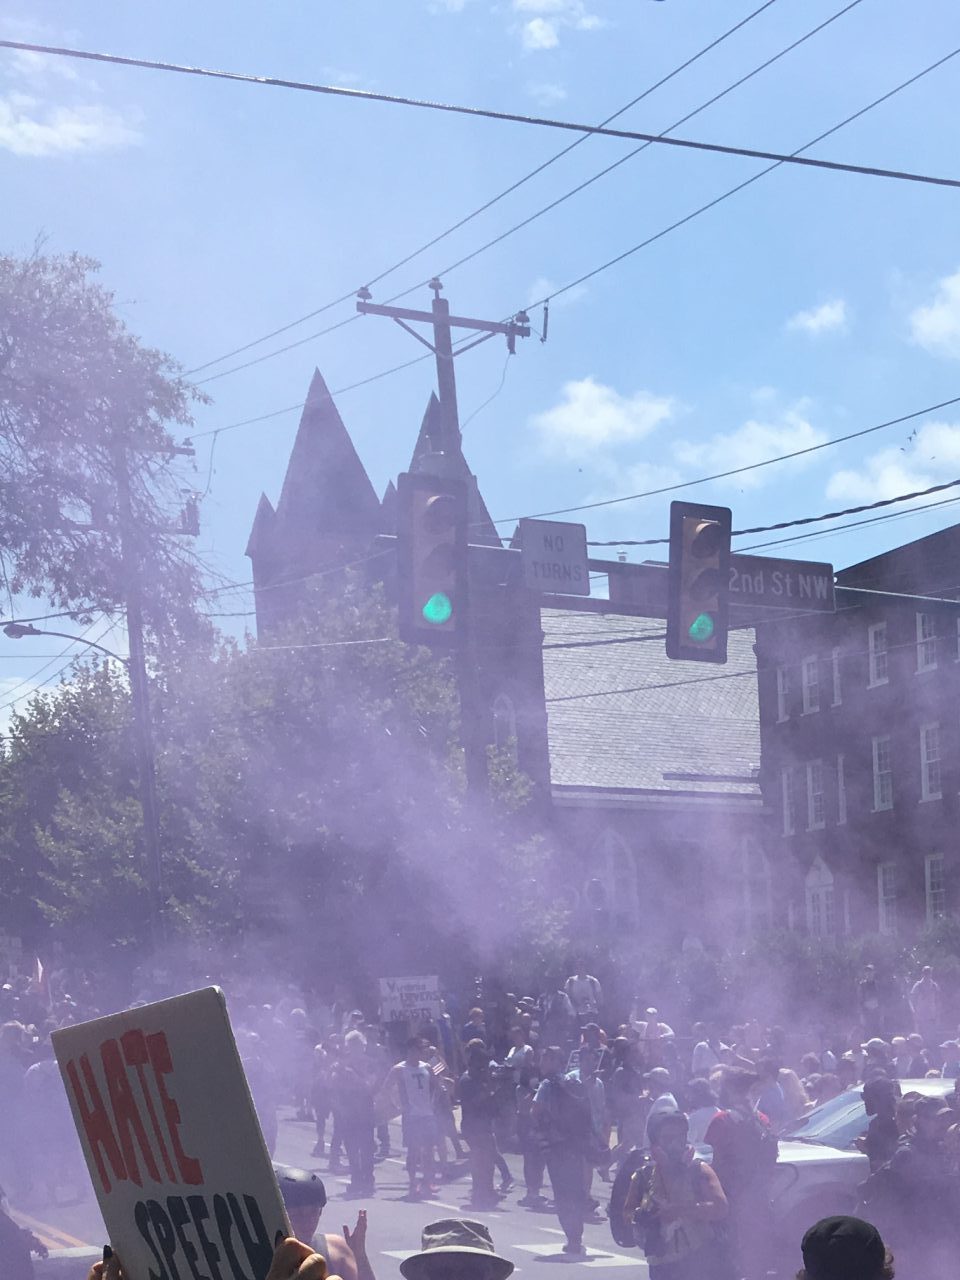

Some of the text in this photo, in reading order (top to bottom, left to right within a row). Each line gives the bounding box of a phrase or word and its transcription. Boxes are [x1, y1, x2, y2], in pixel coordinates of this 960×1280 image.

[543, 534, 564, 552] NO
[532, 560, 583, 582] TURNS
[728, 566, 829, 600] 2nd St NW
[66, 1028, 205, 1194] HATE
